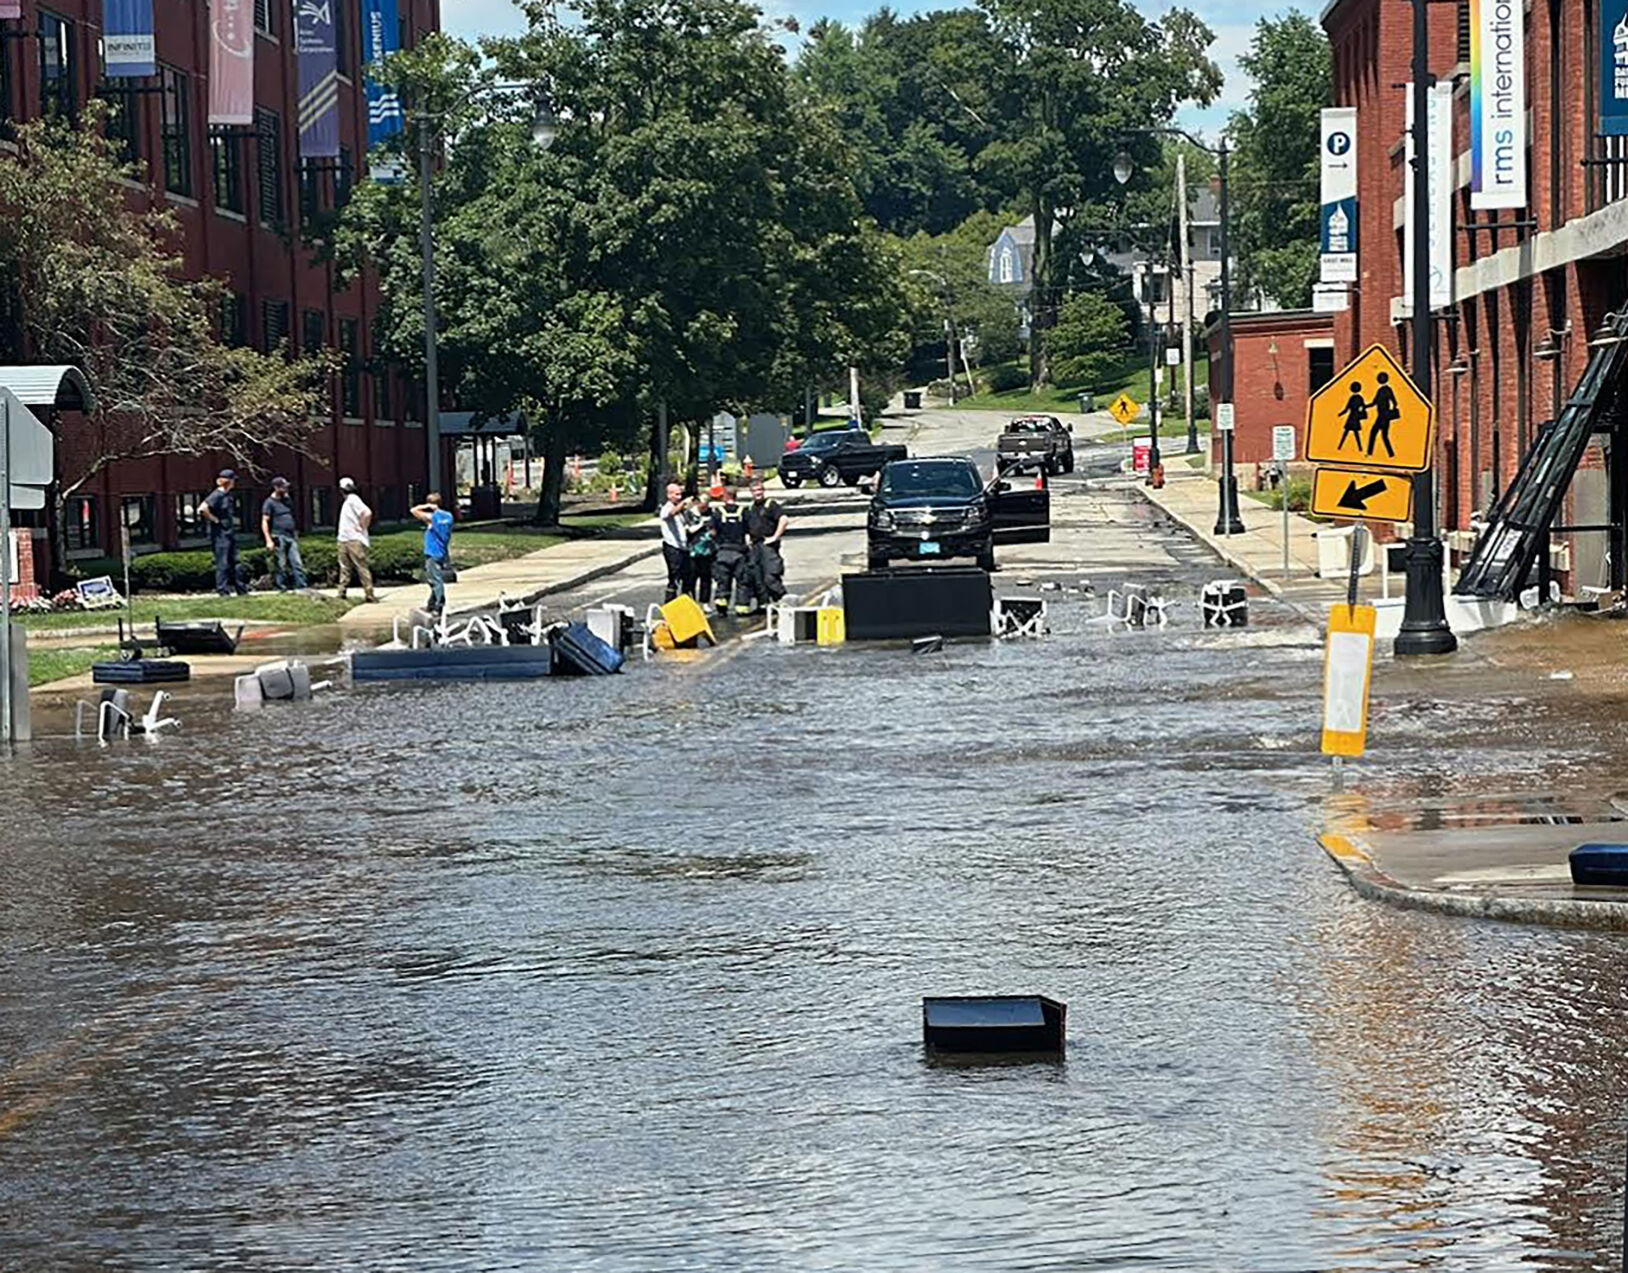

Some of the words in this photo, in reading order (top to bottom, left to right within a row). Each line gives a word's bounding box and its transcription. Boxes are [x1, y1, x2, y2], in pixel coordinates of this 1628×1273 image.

[1490, 0, 1513, 118] internatio
[1333, 134, 1346, 154] P
[1495, 129, 1513, 185] rms
